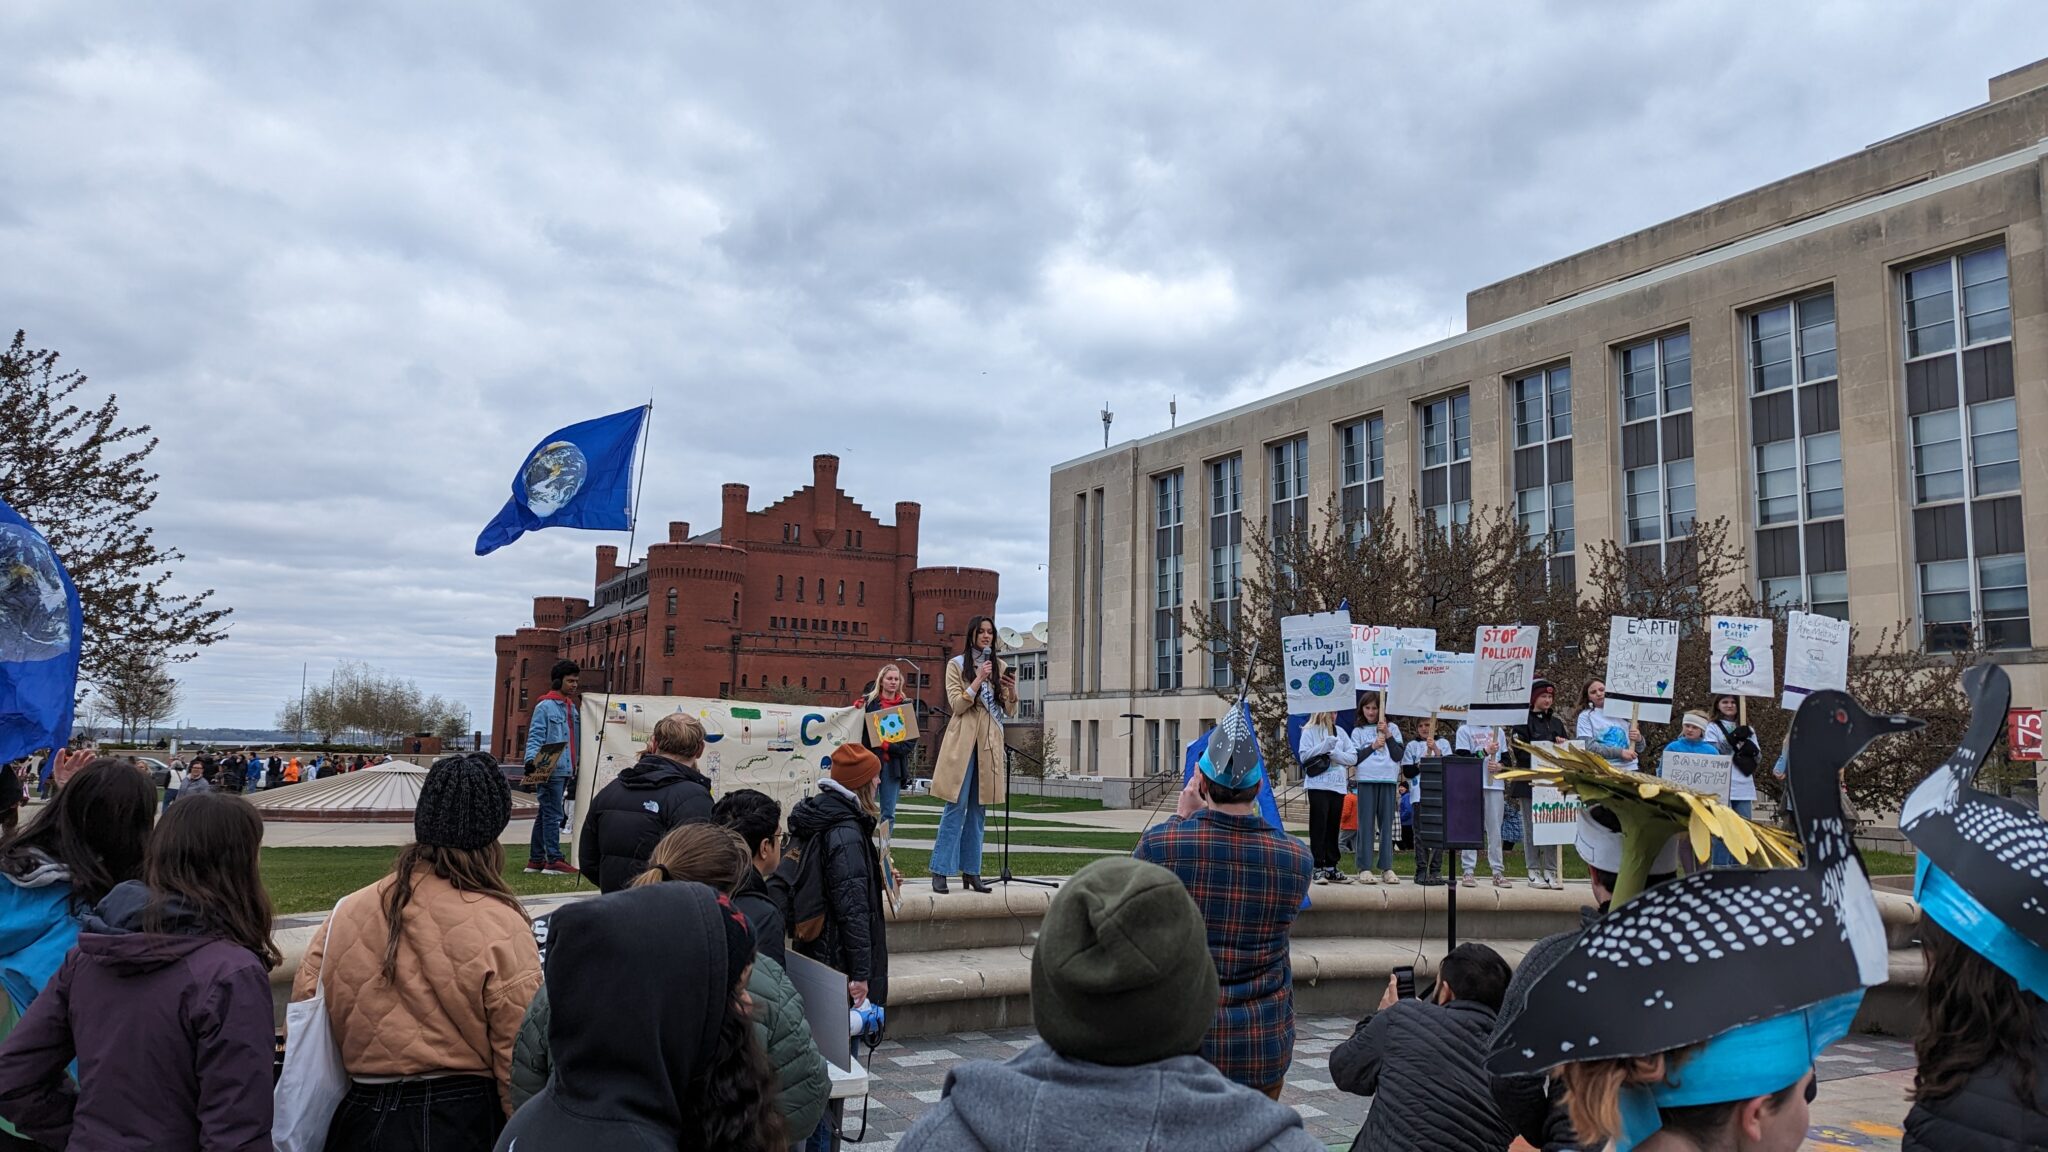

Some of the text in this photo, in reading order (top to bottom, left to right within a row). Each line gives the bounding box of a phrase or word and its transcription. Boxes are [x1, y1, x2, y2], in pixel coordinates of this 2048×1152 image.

[1351, 626, 1380, 642] TOP
[1628, 619, 1677, 635] EARTH
[1484, 629, 1517, 644] STOP
[1283, 637, 1313, 653] Earth
[1315, 637, 1333, 654] Day
[1482, 646, 1533, 660] POLLUTION
[1360, 666, 1391, 684] DYIN
[2018, 714, 2043, 756] 175
[1671, 769, 1728, 786] EARTH
